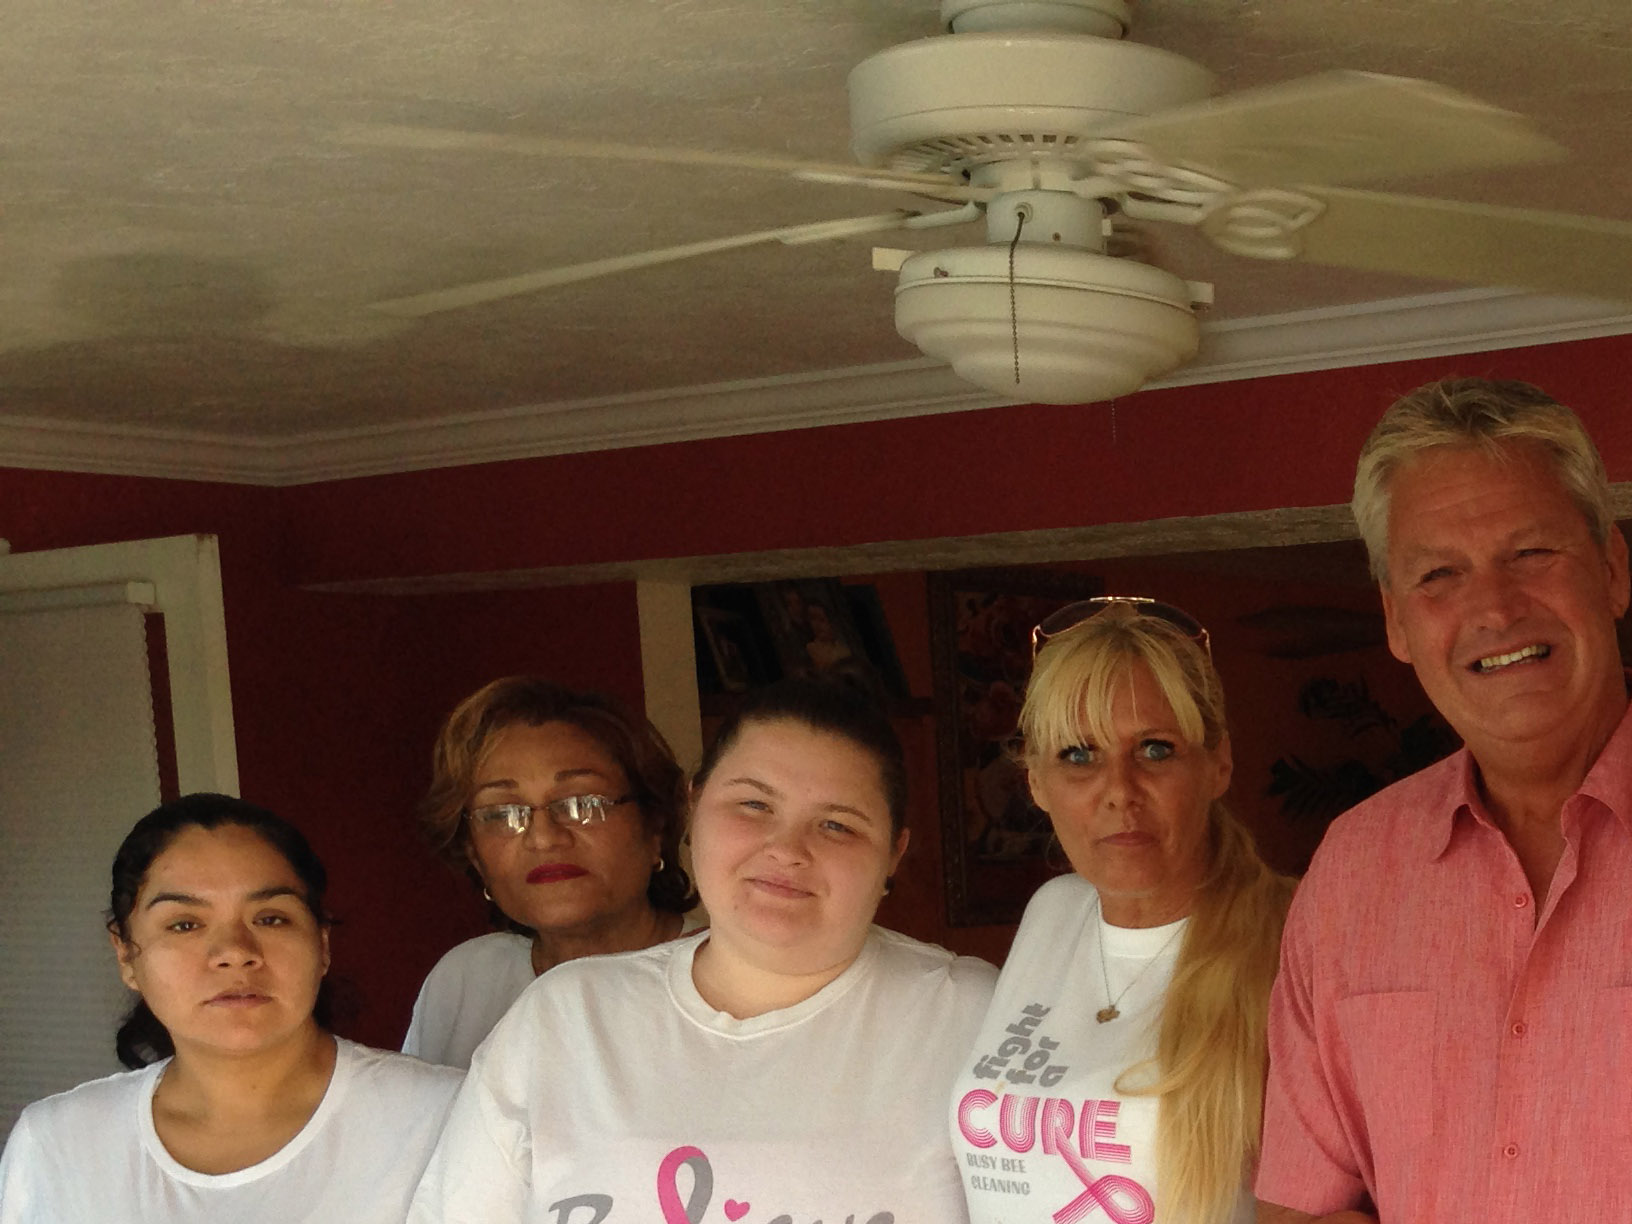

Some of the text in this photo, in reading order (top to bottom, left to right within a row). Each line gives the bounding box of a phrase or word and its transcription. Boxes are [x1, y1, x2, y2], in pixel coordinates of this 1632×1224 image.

[972, 1003, 1051, 1080] fight
[1005, 1036, 1060, 1085] for
[1038, 1066, 1070, 1088] a
[957, 1088, 1133, 1165] CURE
[966, 1152, 1027, 1173] BUSY BEE
[970, 1175, 1031, 1196] CLEANING
